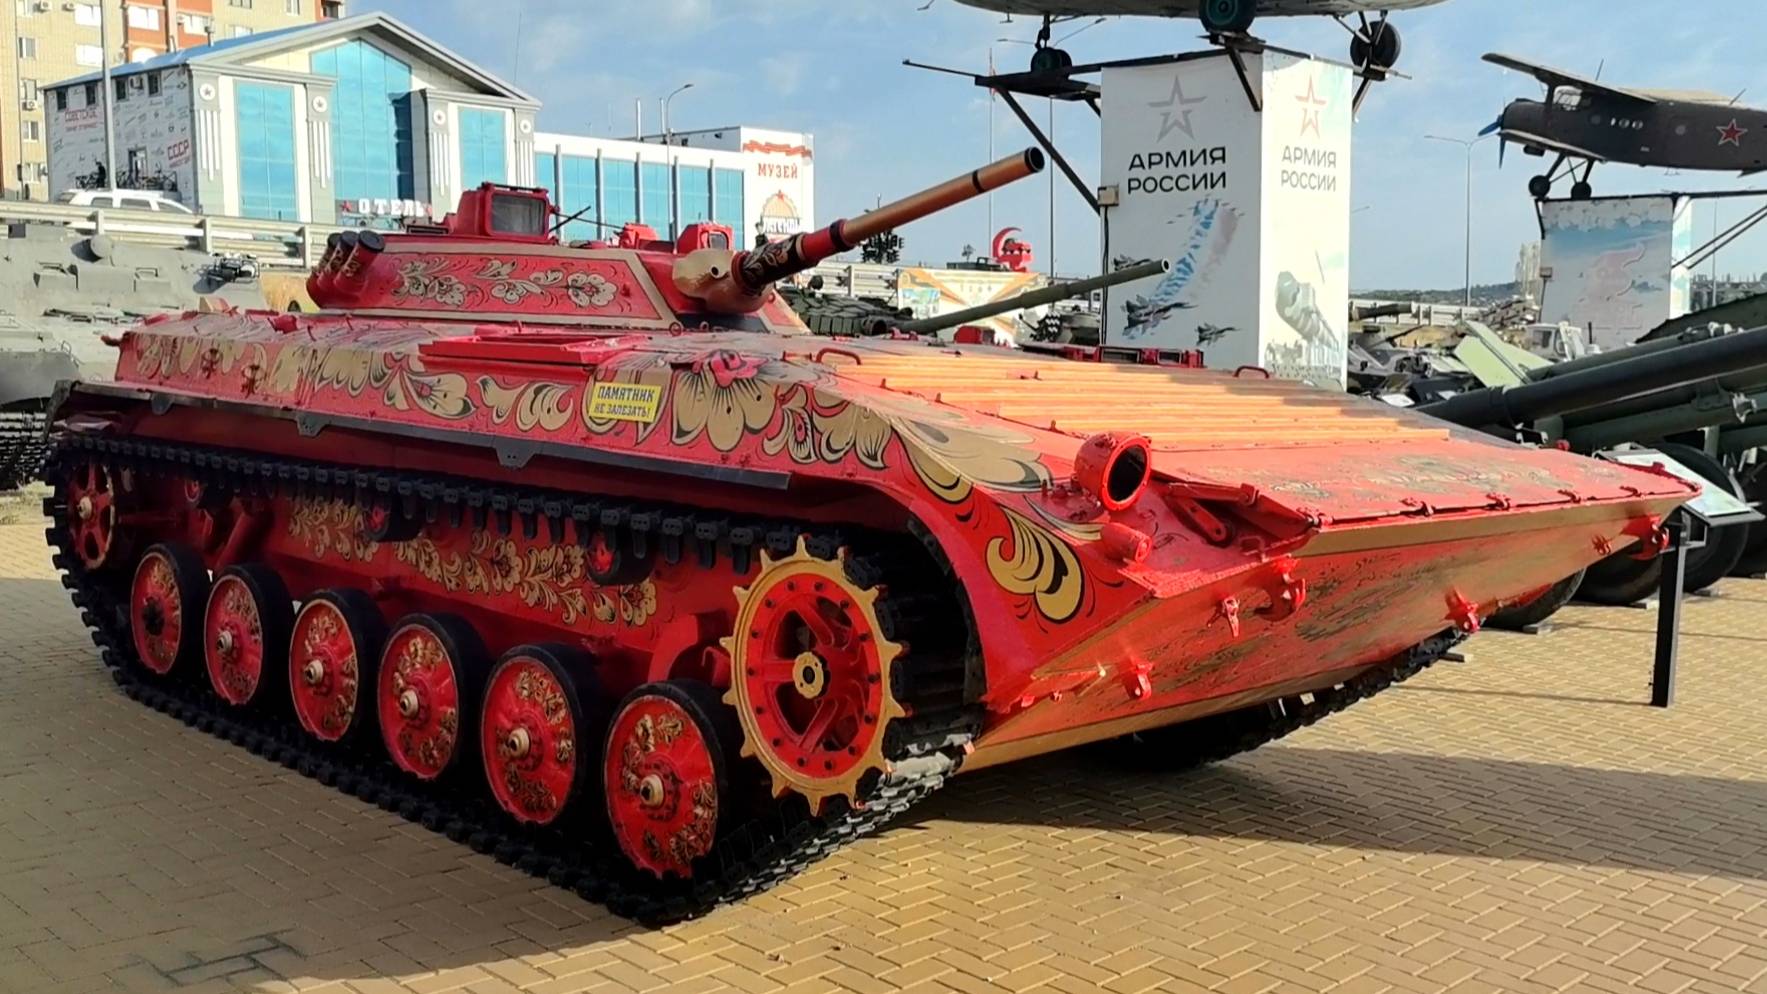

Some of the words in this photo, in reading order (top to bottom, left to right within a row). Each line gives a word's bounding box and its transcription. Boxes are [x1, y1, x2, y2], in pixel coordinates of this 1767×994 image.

[168, 139, 189, 160] СССР
[1128, 146, 1226, 171] АРМИЯ
[1282, 145, 1336, 168] АРМИЯ
[758, 163, 798, 179] МУЗЕЙ
[1281, 169, 1336, 192] РОССИИ
[1127, 171, 1226, 195] РОССИИ
[358, 198, 425, 217] ОТЕЛЬ
[597, 386, 655, 402] ПАМЯТНИК
[594, 403, 606, 414] НЕ
[607, 403, 651, 418] ЗАЛЕЗАТЬ!
